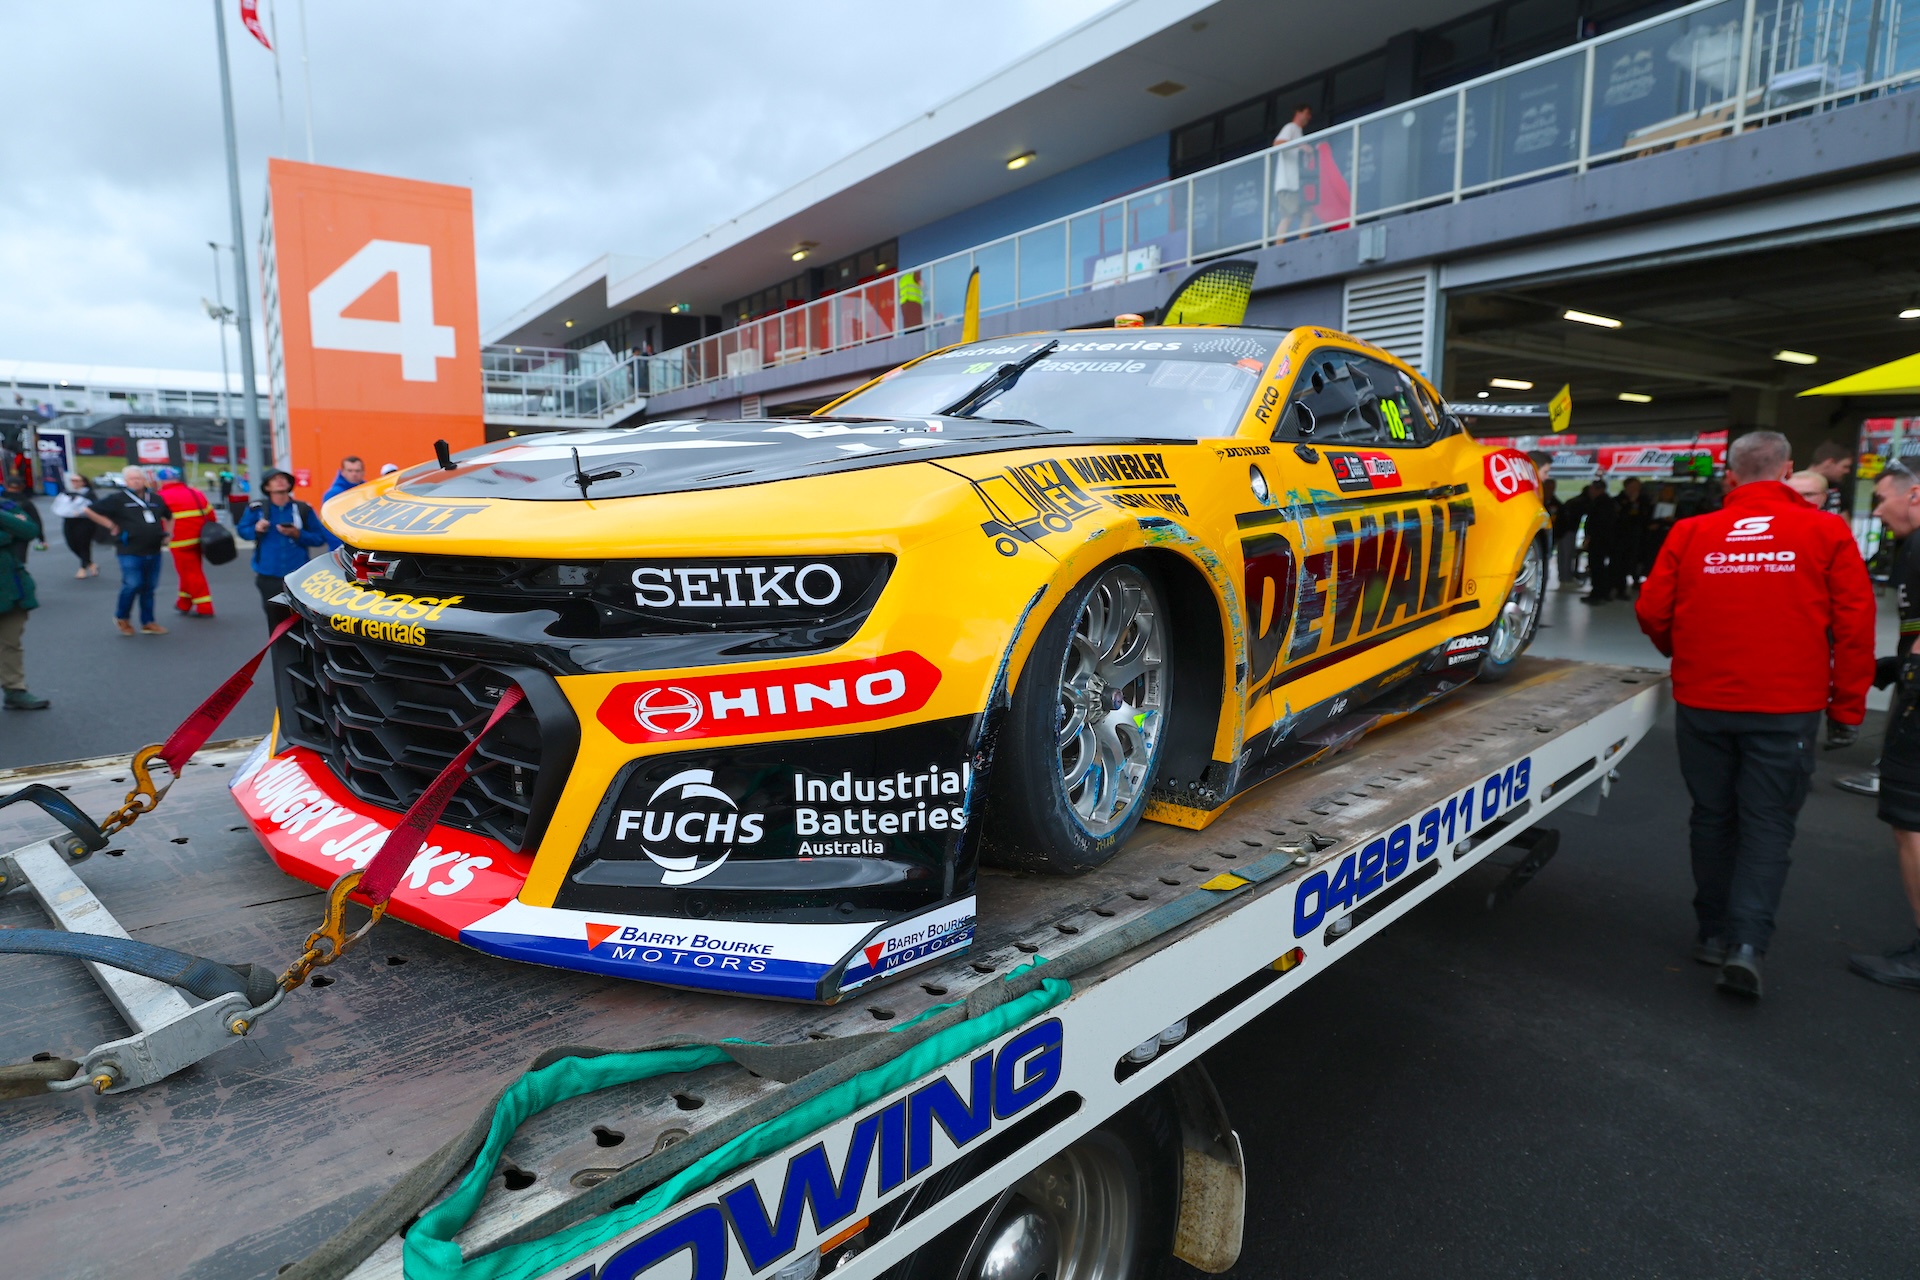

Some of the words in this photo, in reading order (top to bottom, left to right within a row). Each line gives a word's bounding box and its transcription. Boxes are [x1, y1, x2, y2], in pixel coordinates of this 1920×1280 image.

[308, 239, 456, 382] 4
[961, 362, 993, 374] 18
[1029, 360, 1146, 374] Pasquale
[1255, 386, 1279, 424] RYCO
[1380, 399, 1405, 440] 18
[126, 428, 174, 438] TRICO
[1066, 453, 1170, 484] WAVERLEY
[1227, 446, 1271, 458] DUNLOP
[1373, 457, 1396, 477] Repco
[346, 499, 483, 532] DEWALT
[1703, 565, 1761, 574] RECOVERY
[1764, 564, 1795, 572] TEAM
[1728, 551, 1796, 562] HINO
[631, 563, 842, 607] SEIKO
[1241, 497, 1476, 686] DEWALT
[330, 613, 359, 635] car
[361, 618, 426, 647] rentals
[1447, 635, 1489, 652] ACDelco
[709, 669, 906, 720] HINO
[794, 762, 970, 802] Industrial
[254, 755, 356, 842] HUNGRY
[320, 822, 493, 896] JAK'S
[615, 809, 765, 844] FUCHS
[795, 802, 967, 836] Batteries
[798, 839, 884, 856] Australia
[1293, 823, 1412, 939] 0429
[1416, 787, 1475, 862] 311
[1481, 756, 1532, 823] 013
[619, 926, 688, 948] BARRY
[690, 934, 774, 956] BOURKE
[886, 929, 969, 968] MOTORS
[887, 930, 925, 952] BARRY
[611, 945, 766, 973] MOTORS
[564, 1016, 1063, 1280] OWING
